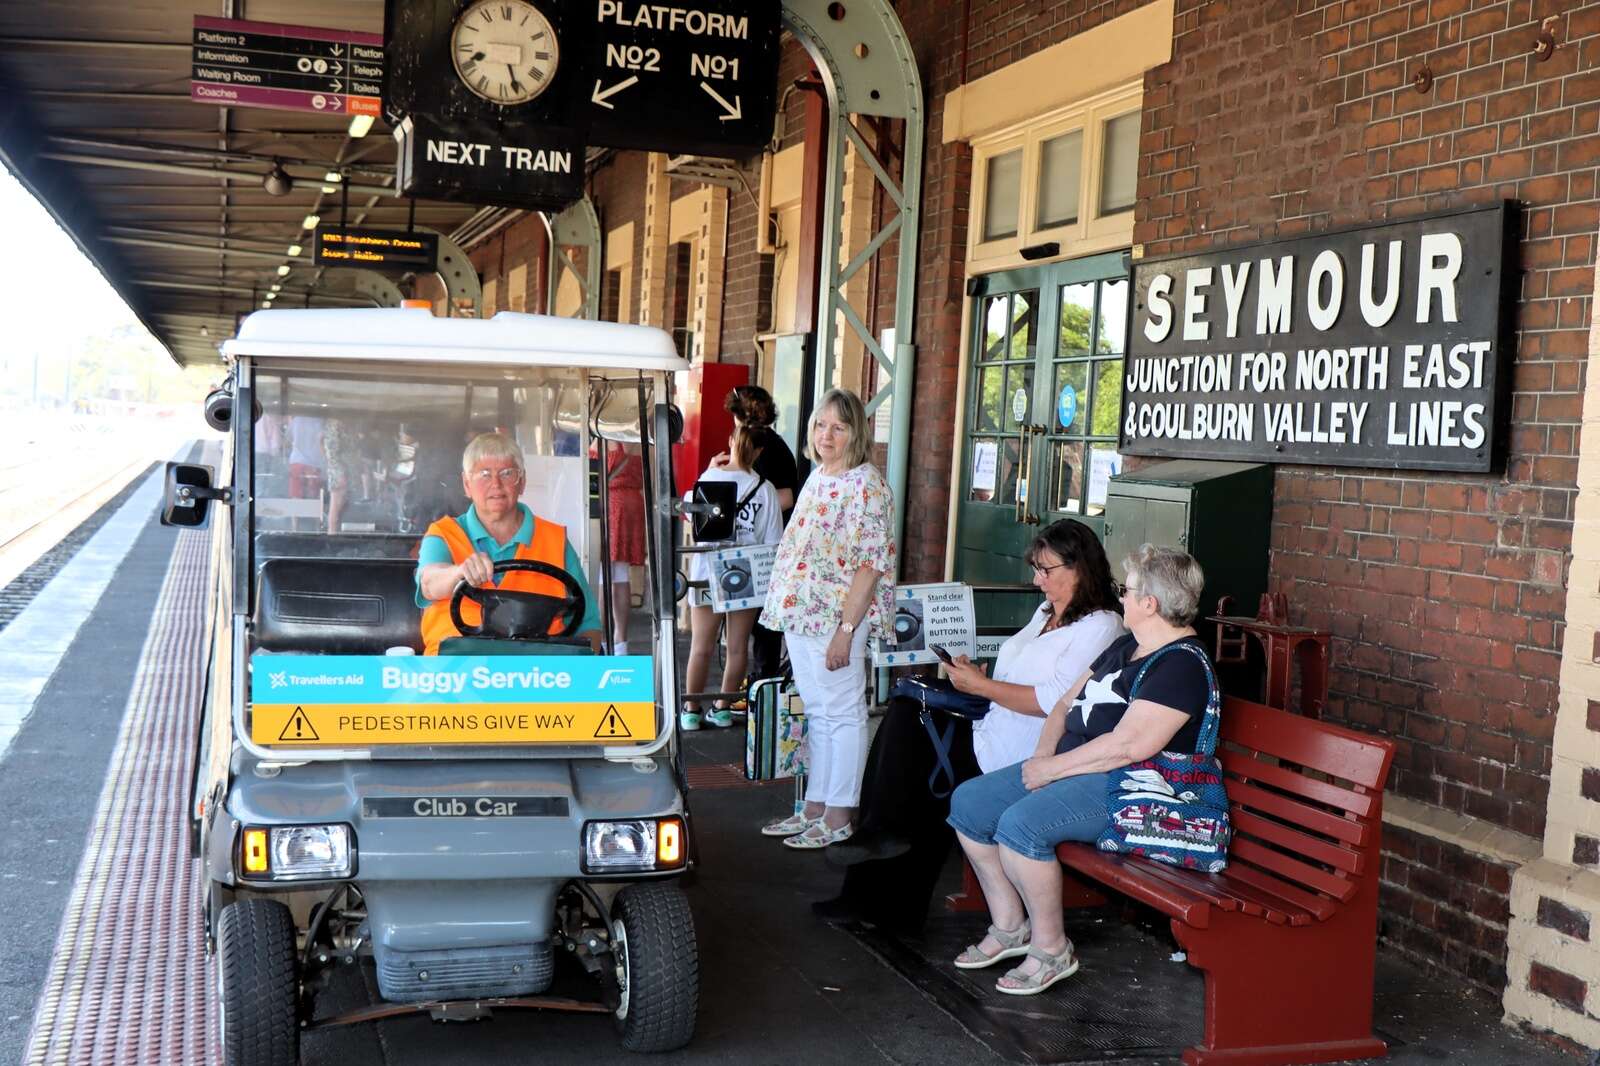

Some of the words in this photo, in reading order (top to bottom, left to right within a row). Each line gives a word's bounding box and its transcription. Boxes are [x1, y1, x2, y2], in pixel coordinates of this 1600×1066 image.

[597, 0, 749, 40] PLATFORM
[198, 31, 237, 45] Platform
[238, 35, 246, 46] 2
[198, 51, 249, 64] Information
[197, 68, 231, 82] Waiting
[233, 71, 261, 82] Room
[196, 86, 238, 100] Coaches
[352, 82, 380, 95] Toilets
[352, 100, 379, 112] Buses
[426, 139, 491, 167] NEXT
[501, 146, 571, 174] TRAIN
[1144, 231, 1463, 343] SEYMOUR
[1126, 353, 1233, 393] JUNCTION
[1238, 351, 1287, 393] FOR
[1295, 346, 1389, 391] NORTH
[1402, 340, 1492, 389] EAST
[1263, 401, 1369, 444] VALLEY
[1386, 401, 1486, 449] LINES
[929, 629, 958, 637] BUTTON
[289, 675, 344, 685] Travellers
[345, 675, 364, 685] Aid
[382, 666, 467, 694] Buggy
[472, 667, 571, 689] Service
[339, 715, 479, 731] PEDESTRIANS
[485, 715, 529, 730] GIVE
[535, 714, 575, 729] WAY
[413, 798, 467, 816] Club
[475, 798, 517, 816] Car
